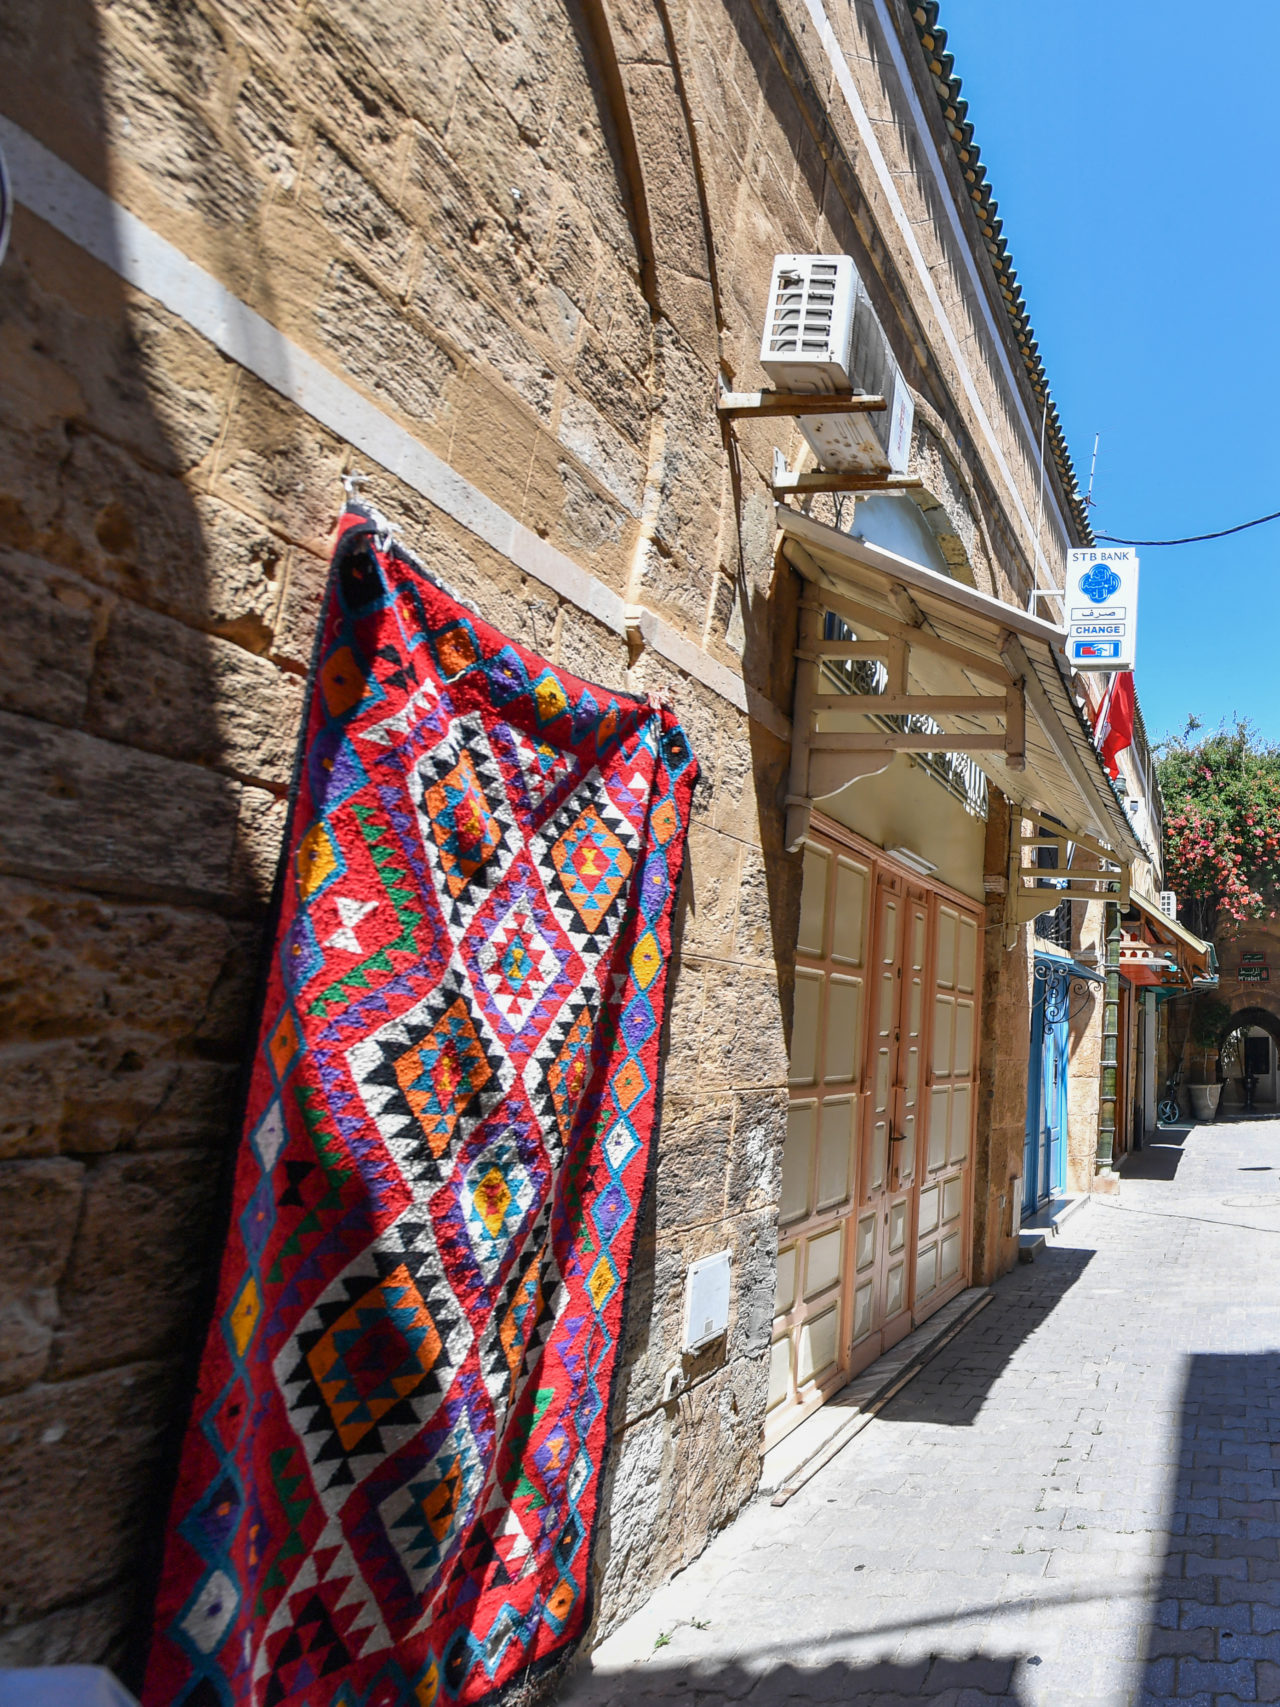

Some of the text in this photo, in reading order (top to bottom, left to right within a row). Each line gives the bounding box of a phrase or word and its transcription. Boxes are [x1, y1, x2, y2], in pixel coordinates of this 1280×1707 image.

[1072, 551, 1130, 562] STB BANK
[1081, 609, 1116, 619] صرف
[1075, 625, 1121, 634] CHANGE
